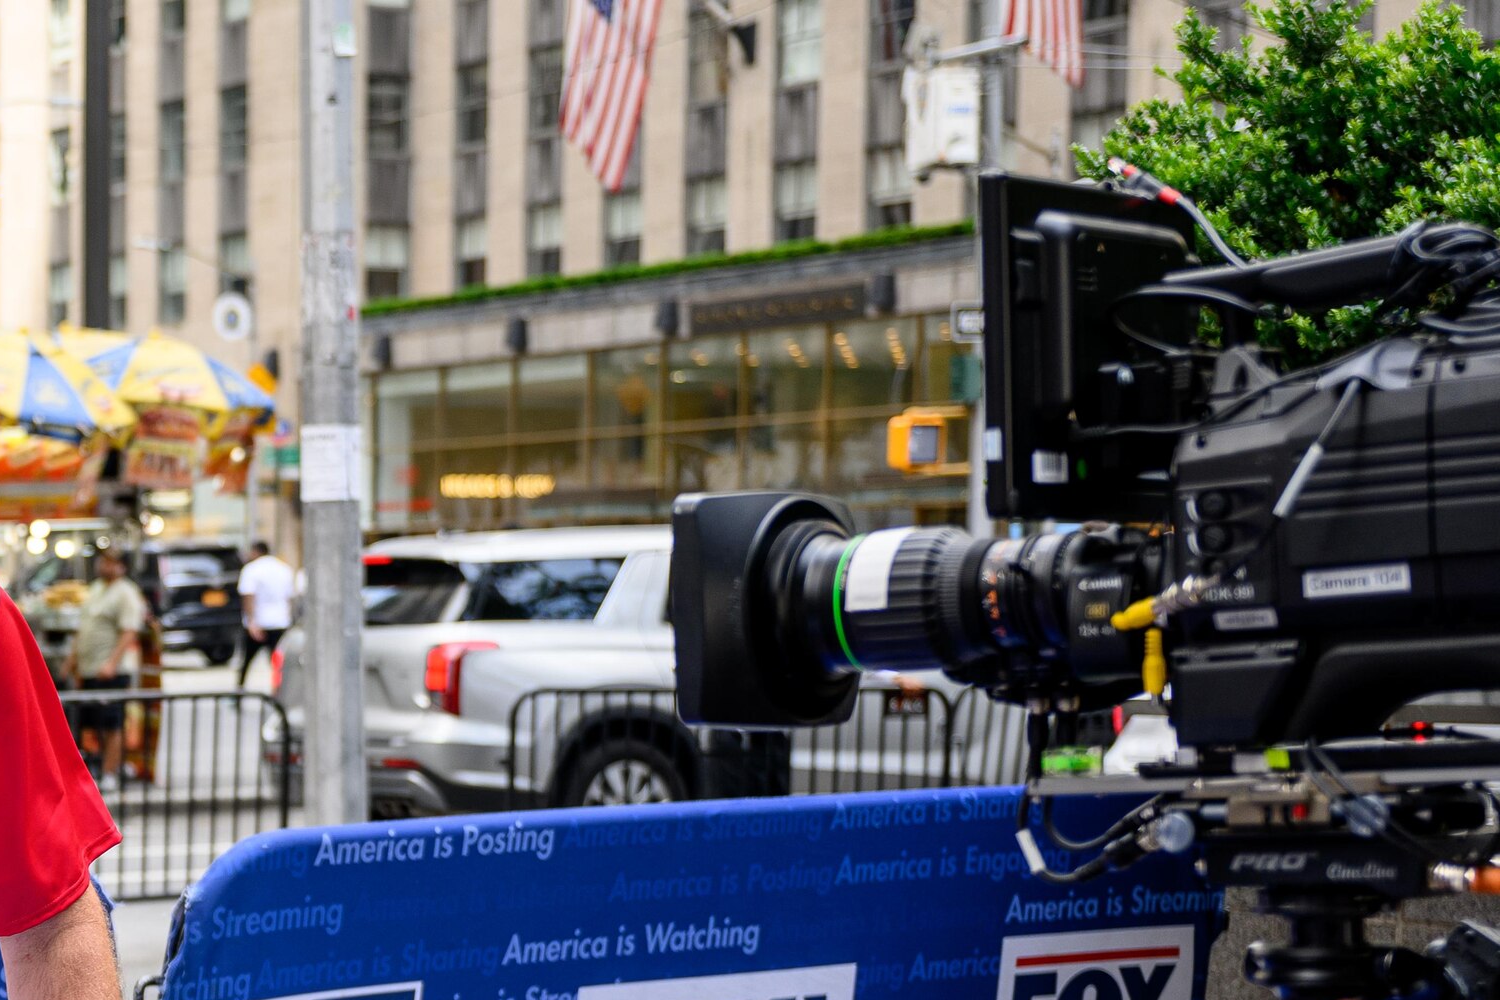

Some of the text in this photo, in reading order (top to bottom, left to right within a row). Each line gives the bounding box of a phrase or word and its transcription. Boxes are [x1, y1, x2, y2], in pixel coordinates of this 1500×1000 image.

[314, 828, 424, 867] America
[433, 825, 453, 859] is
[462, 821, 555, 860] Posting
[830, 797, 926, 831] America
[609, 867, 712, 901] America
[834, 849, 932, 887] America
[940, 846, 957, 877] is
[211, 895, 345, 940] Streaming
[1004, 889, 1098, 925] America
[1106, 886, 1123, 917] is
[255, 952, 363, 992] America
[501, 926, 609, 967] America
[615, 923, 637, 957] is
[644, 914, 762, 956] Watching
